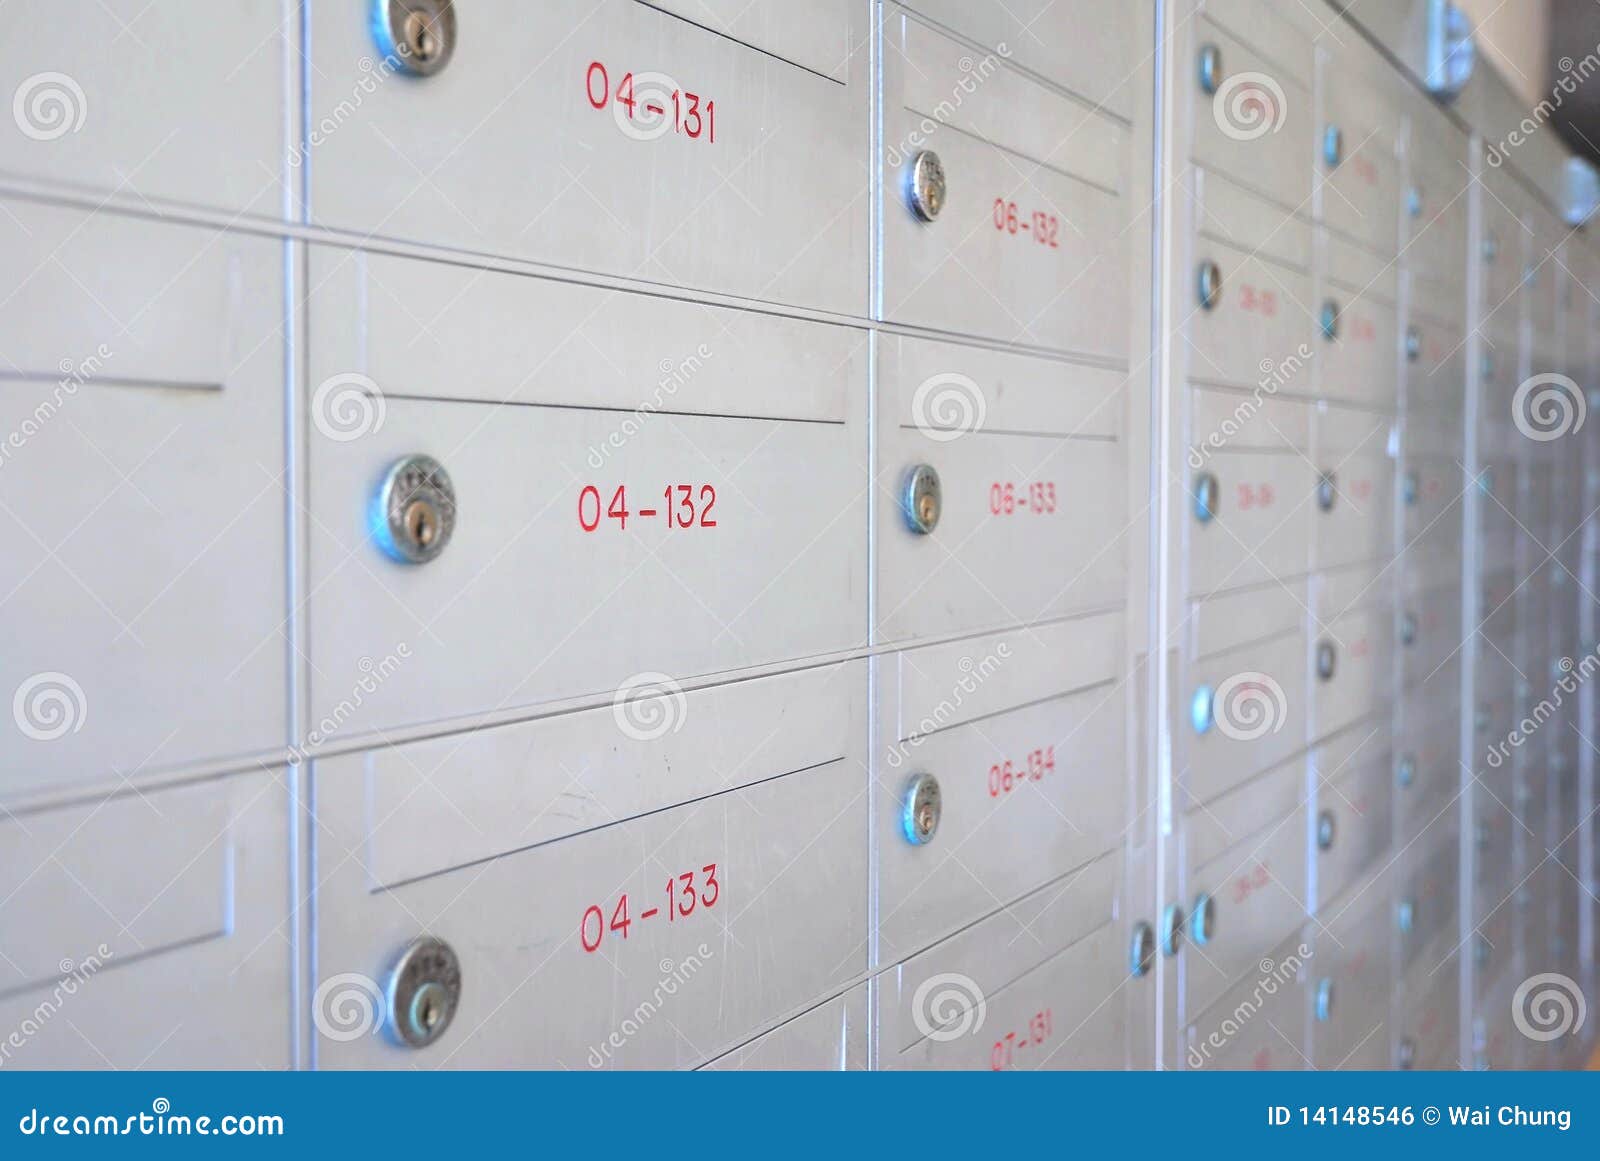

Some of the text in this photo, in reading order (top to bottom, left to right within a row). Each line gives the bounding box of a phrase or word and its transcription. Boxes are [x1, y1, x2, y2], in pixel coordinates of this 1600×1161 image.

[585, 61, 715, 144] 04-131
[993, 197, 1059, 248] 06-132
[578, 483, 718, 533] 04-132
[991, 482, 1055, 516] 06-133
[989, 747, 1055, 798] 06-134
[580, 863, 720, 954] 04-133
